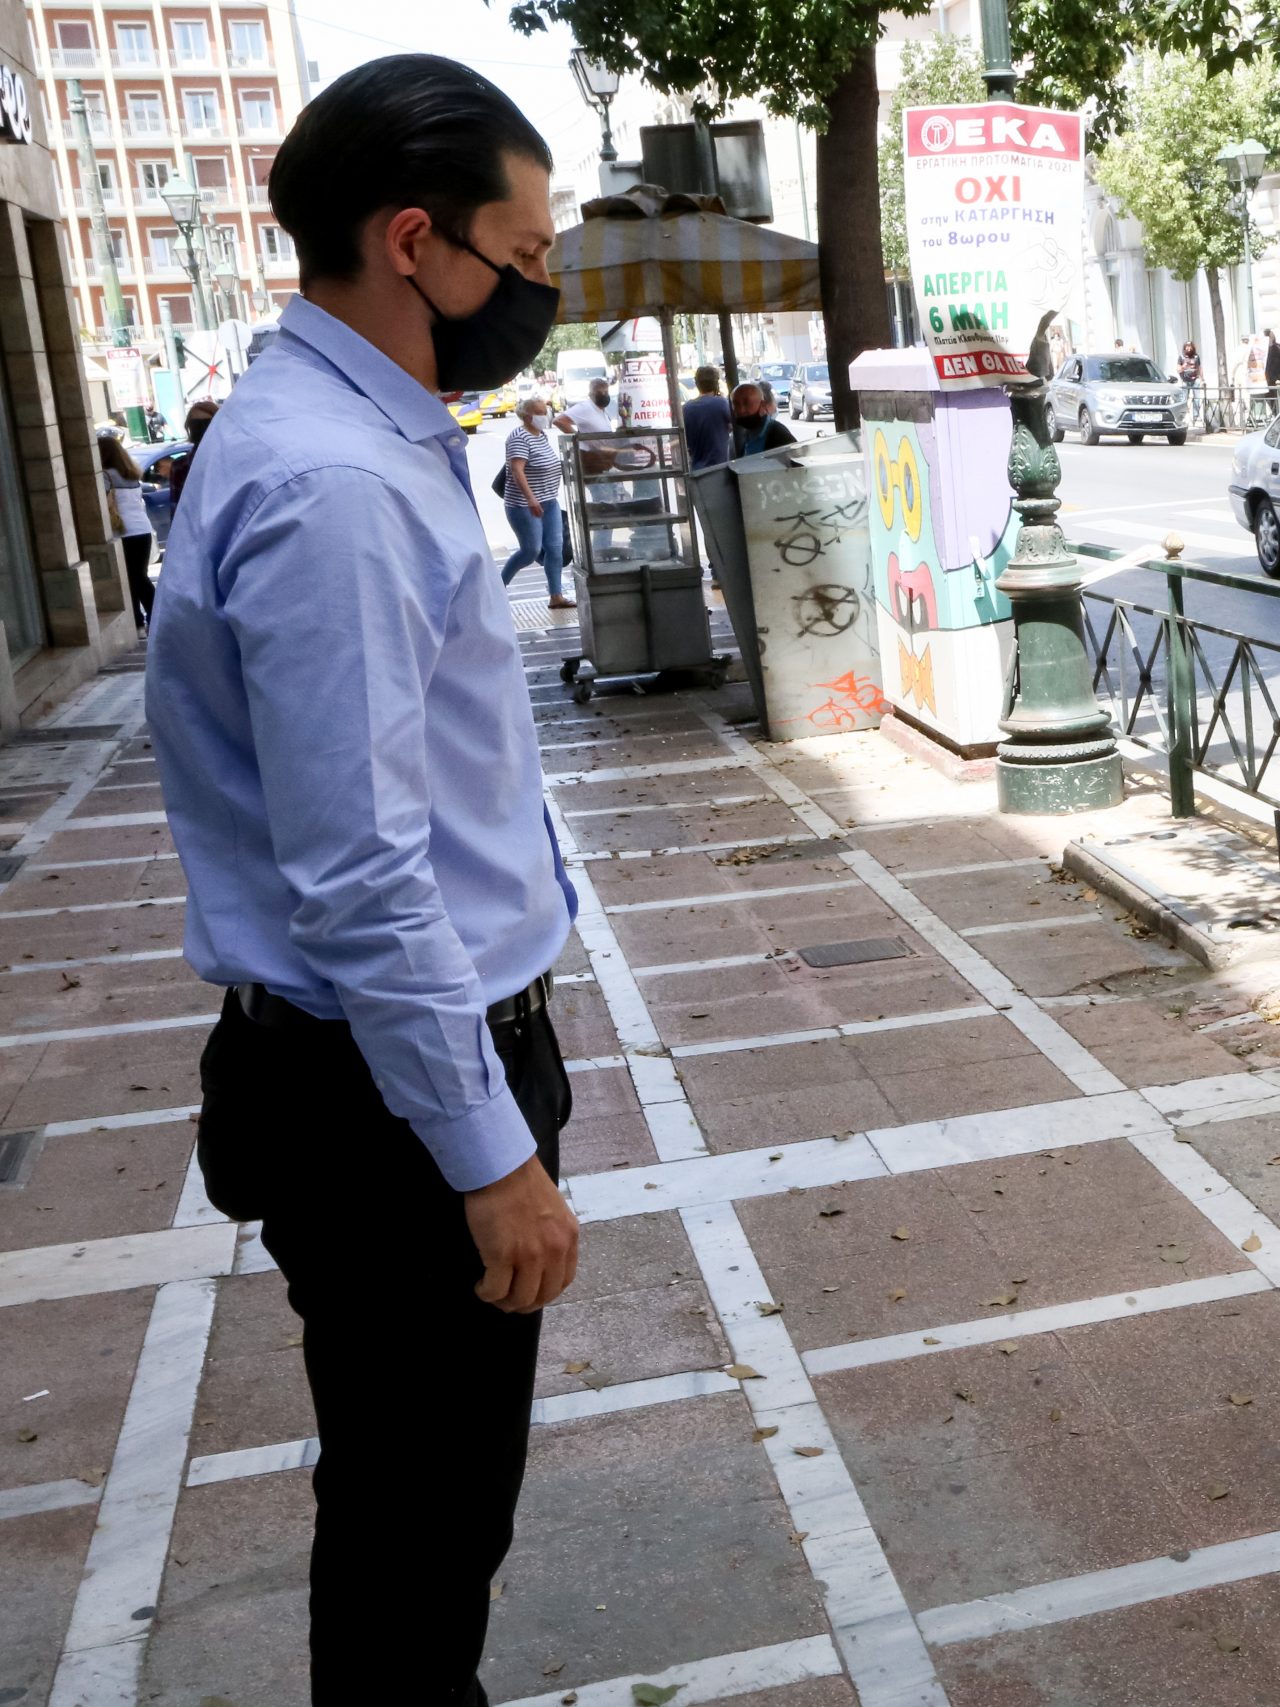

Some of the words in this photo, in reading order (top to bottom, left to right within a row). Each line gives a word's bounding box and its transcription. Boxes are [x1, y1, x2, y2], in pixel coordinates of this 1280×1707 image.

[916, 156, 967, 169] ΕΡΓΑΤΙΚΗ
[955, 175, 1021, 204] ΟΧΙ
[921, 215, 949, 227] στην
[955, 207, 1054, 224] ΚΑΤΑΡΓΗΣΗ
[922, 239, 942, 247] του
[948, 231, 1011, 247] 8ωρου
[924, 271, 1008, 296] ΑΠΕΡΓΙΑ
[929, 306, 944, 333] 6
[948, 302, 1008, 331] ΜΑΗ
[943, 354, 979, 376] ΔΕΝ
[981, 352, 1005, 372] ΘΑ
